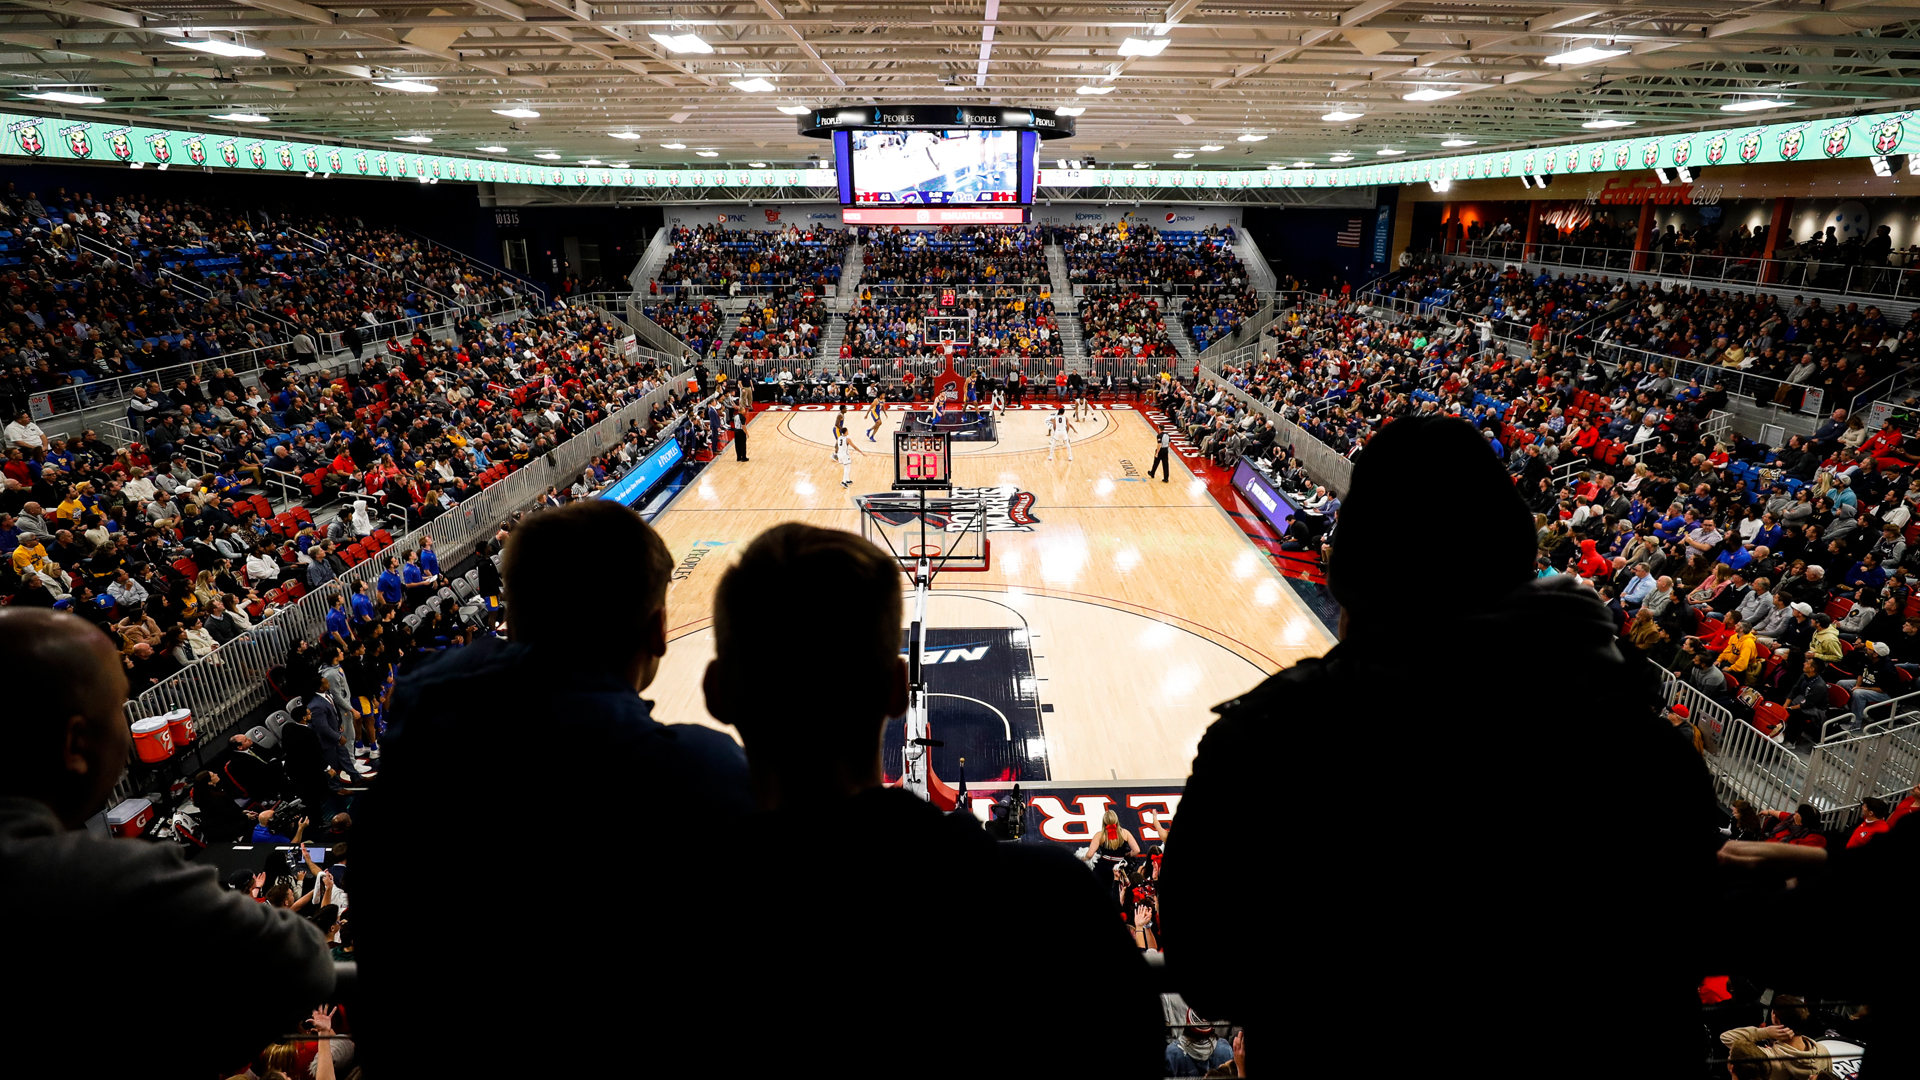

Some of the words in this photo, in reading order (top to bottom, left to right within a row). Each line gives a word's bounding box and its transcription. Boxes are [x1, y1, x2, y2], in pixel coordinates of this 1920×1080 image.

[821, 117, 842, 126] PEOPLES
[883, 114, 914, 123] PEOPLES
[965, 114, 997, 123] PEOPLES
[1035, 117, 1056, 127] PEOPLES
[1584, 191, 1599, 205] THE
[1692, 188, 1722, 206] CLUB
[495, 213, 503, 225] 10
[503, 213, 511, 225] 13
[511, 213, 520, 225] 15
[728, 214, 746, 222] PNC
[941, 211, 1004, 221] RMUATHLETICS
[1075, 212, 1102, 221] KOPPERS
[941, 295, 954, 306] 23
[839, 438, 844, 447] 3
[660, 445, 679, 466] PEOPLES
[907, 453, 938, 478] 23
[671, 549, 711, 580] PEOPLES
[1709, 719, 1722, 733] 115
[162, 731, 170, 742] G
[136, 813, 147, 828] G
